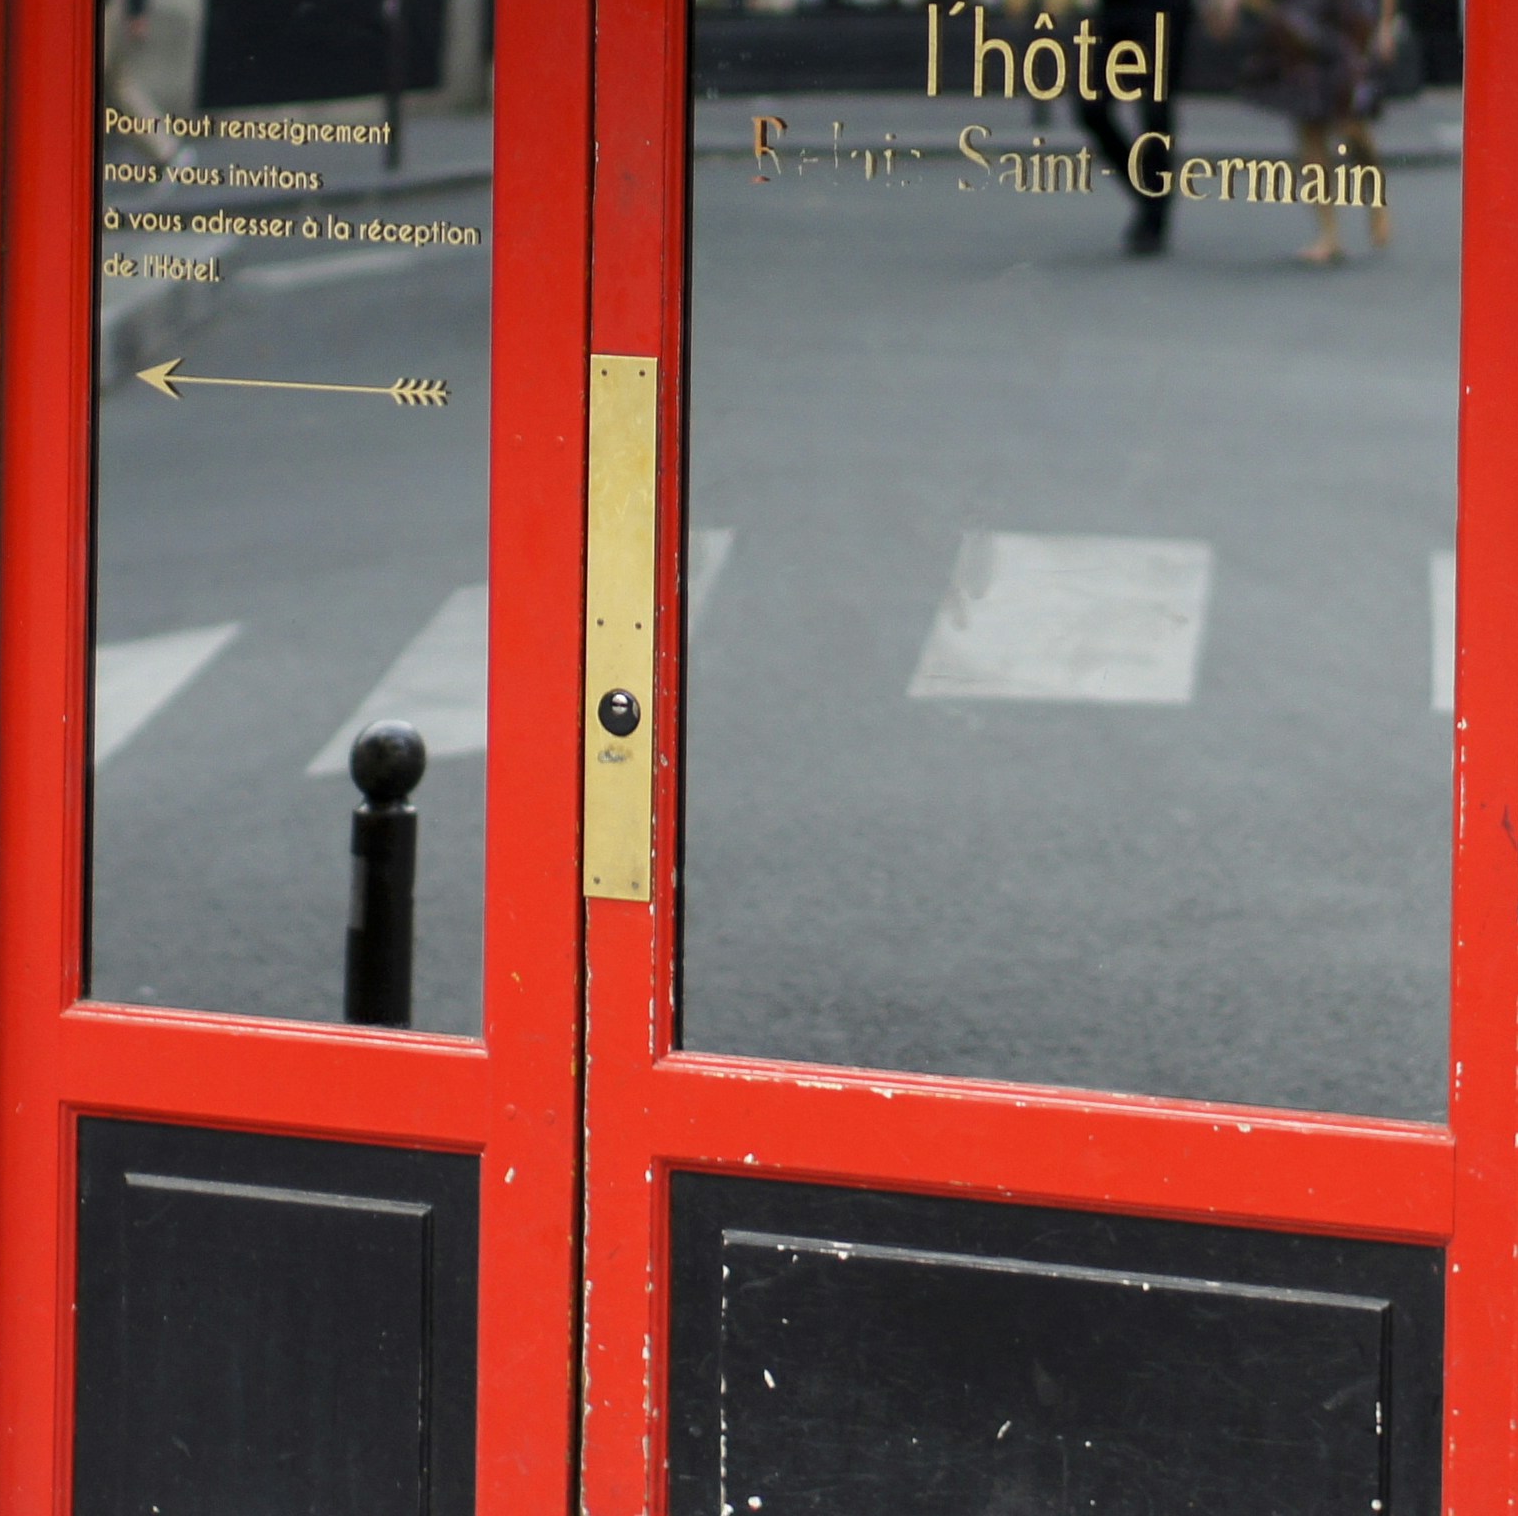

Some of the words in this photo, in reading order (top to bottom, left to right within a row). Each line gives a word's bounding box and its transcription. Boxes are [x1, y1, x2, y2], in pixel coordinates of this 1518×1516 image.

[105, 108, 156, 135] Pour
[165, 114, 212, 138] tout
[220, 117, 392, 146] renseignement
[105, 163, 158, 182] nous
[167, 166, 221, 186] vous
[229, 163, 323, 190] invitons
[104, 207, 119, 230] à
[129, 212, 183, 232] vous
[191, 209, 293, 237] adresser
[302, 215, 320, 239] à
[327, 214, 350, 240] la
[359, 218, 482, 249] réception
[103, 252, 137, 278] de
